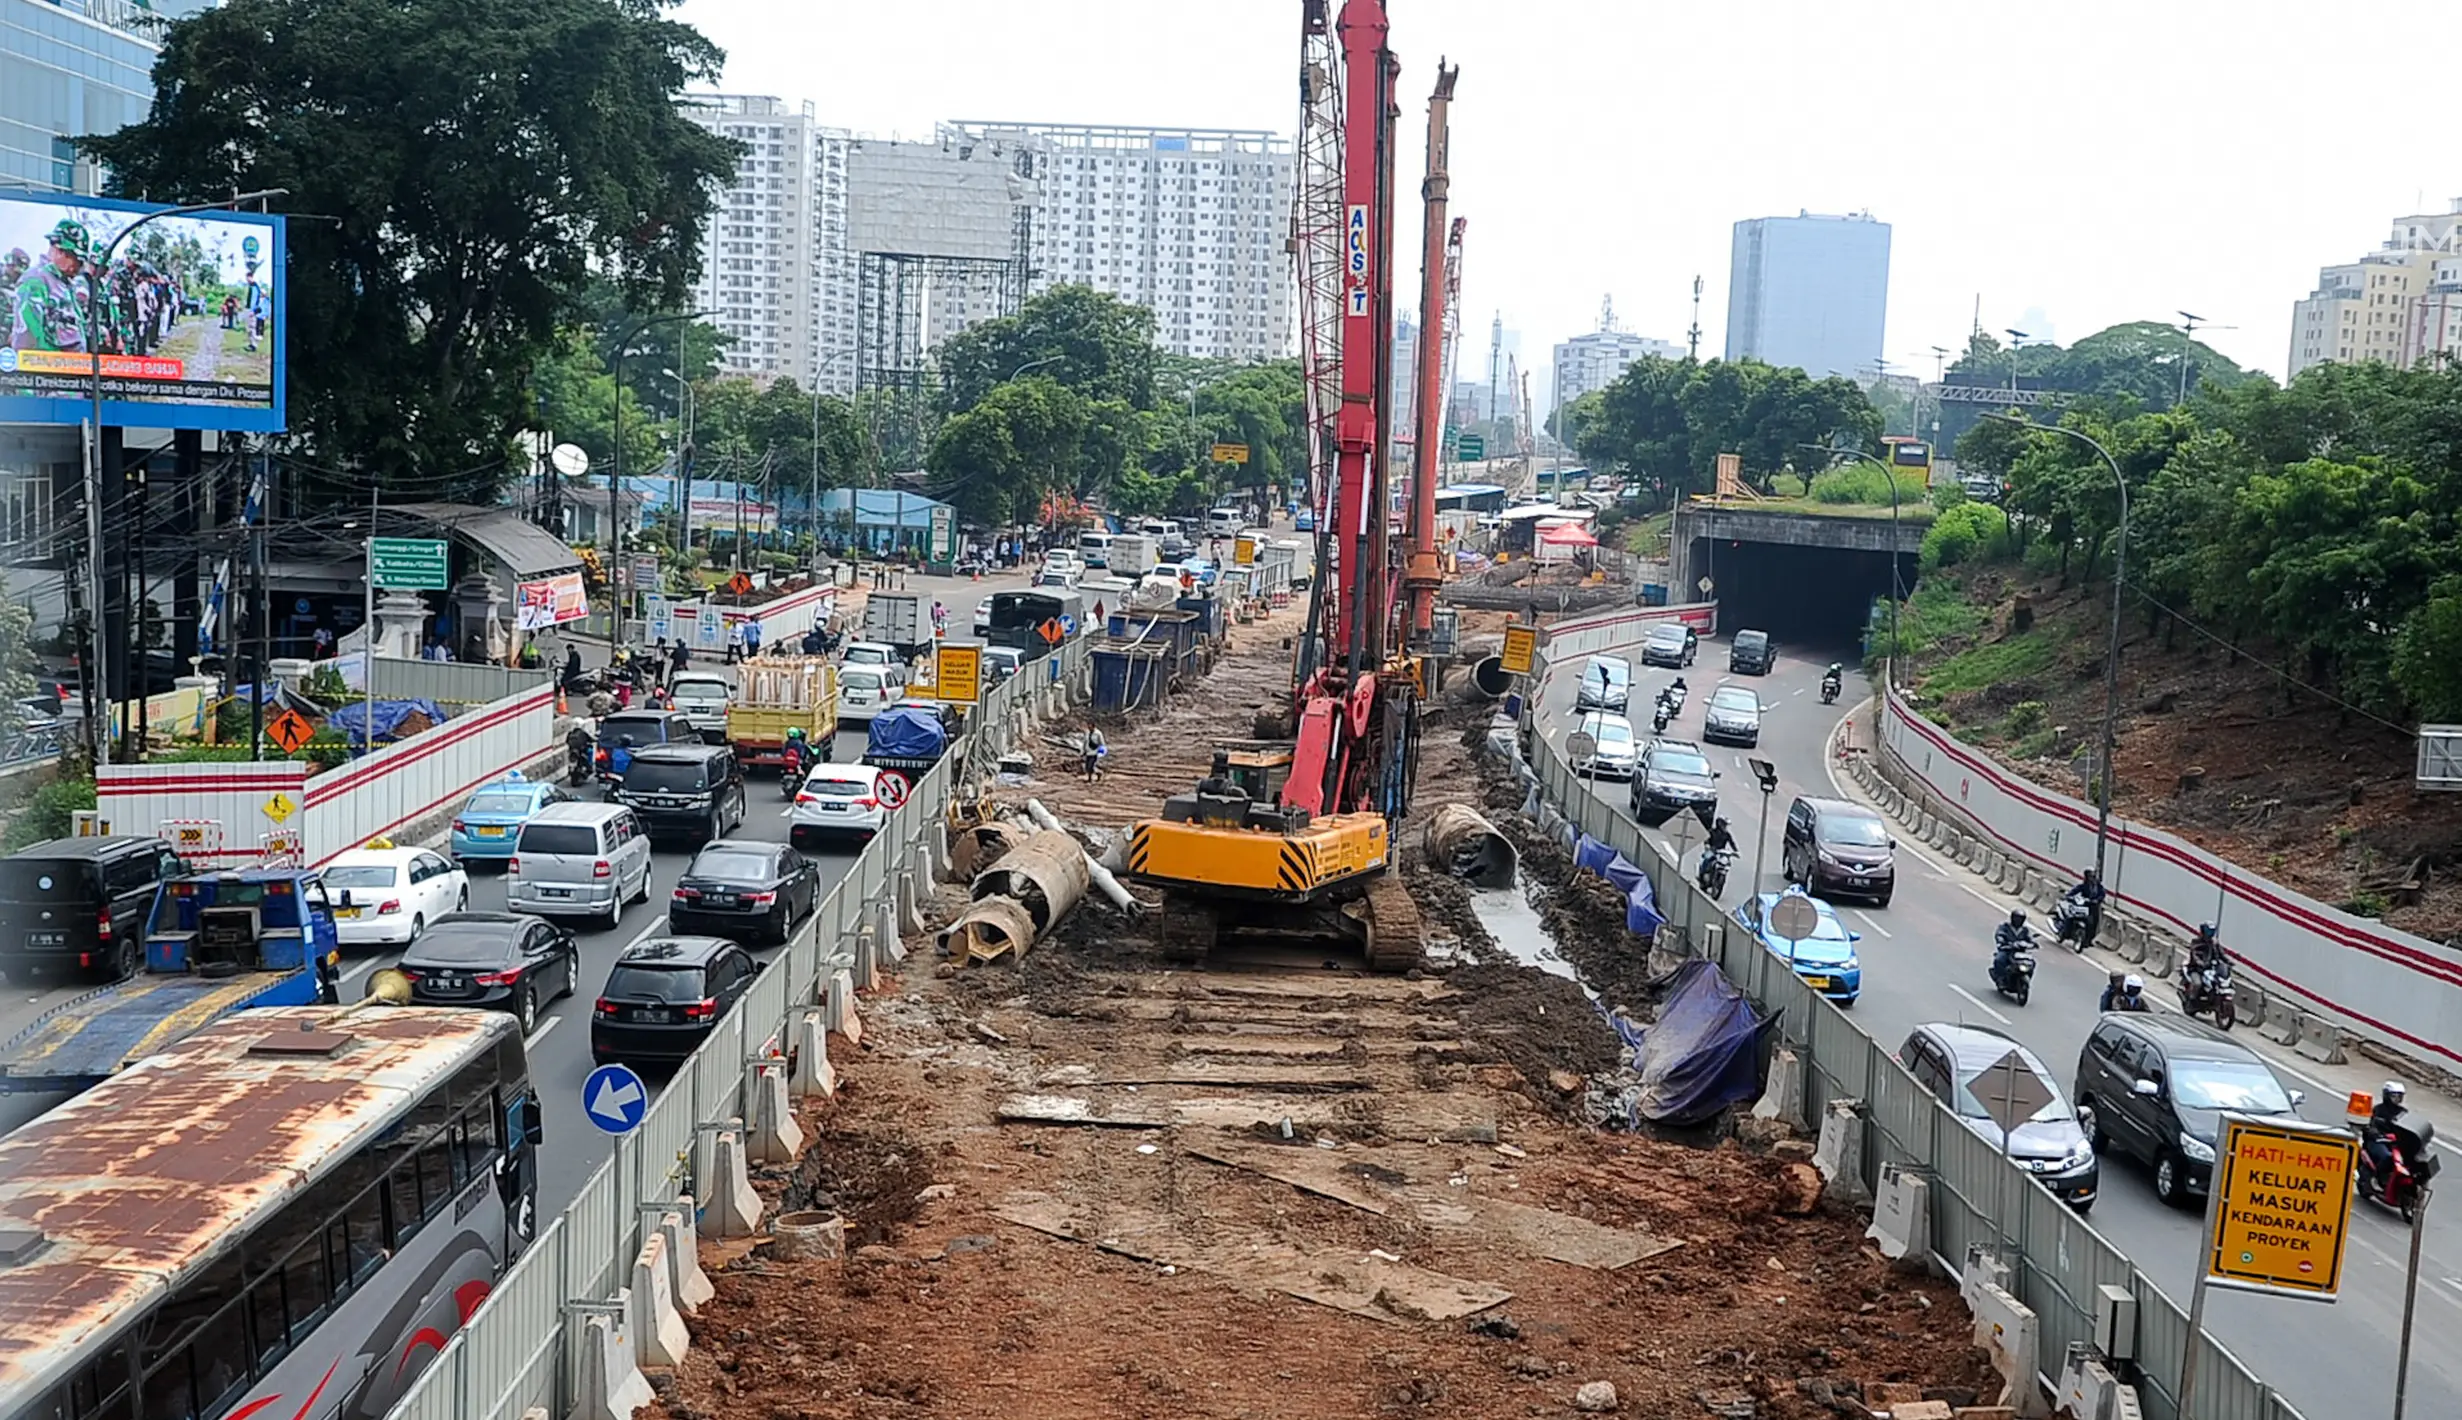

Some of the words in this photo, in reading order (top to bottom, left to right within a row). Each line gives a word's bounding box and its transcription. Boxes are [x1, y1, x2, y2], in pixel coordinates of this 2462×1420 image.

[2240, 1145, 2342, 1172] HATI-HATI
[2248, 1169, 2327, 1194] KELUAR
[2250, 1192, 2318, 1215] MASUK
[2231, 1210, 2333, 1236] KENDARAAN
[2247, 1231, 2311, 1251] PROYEK
